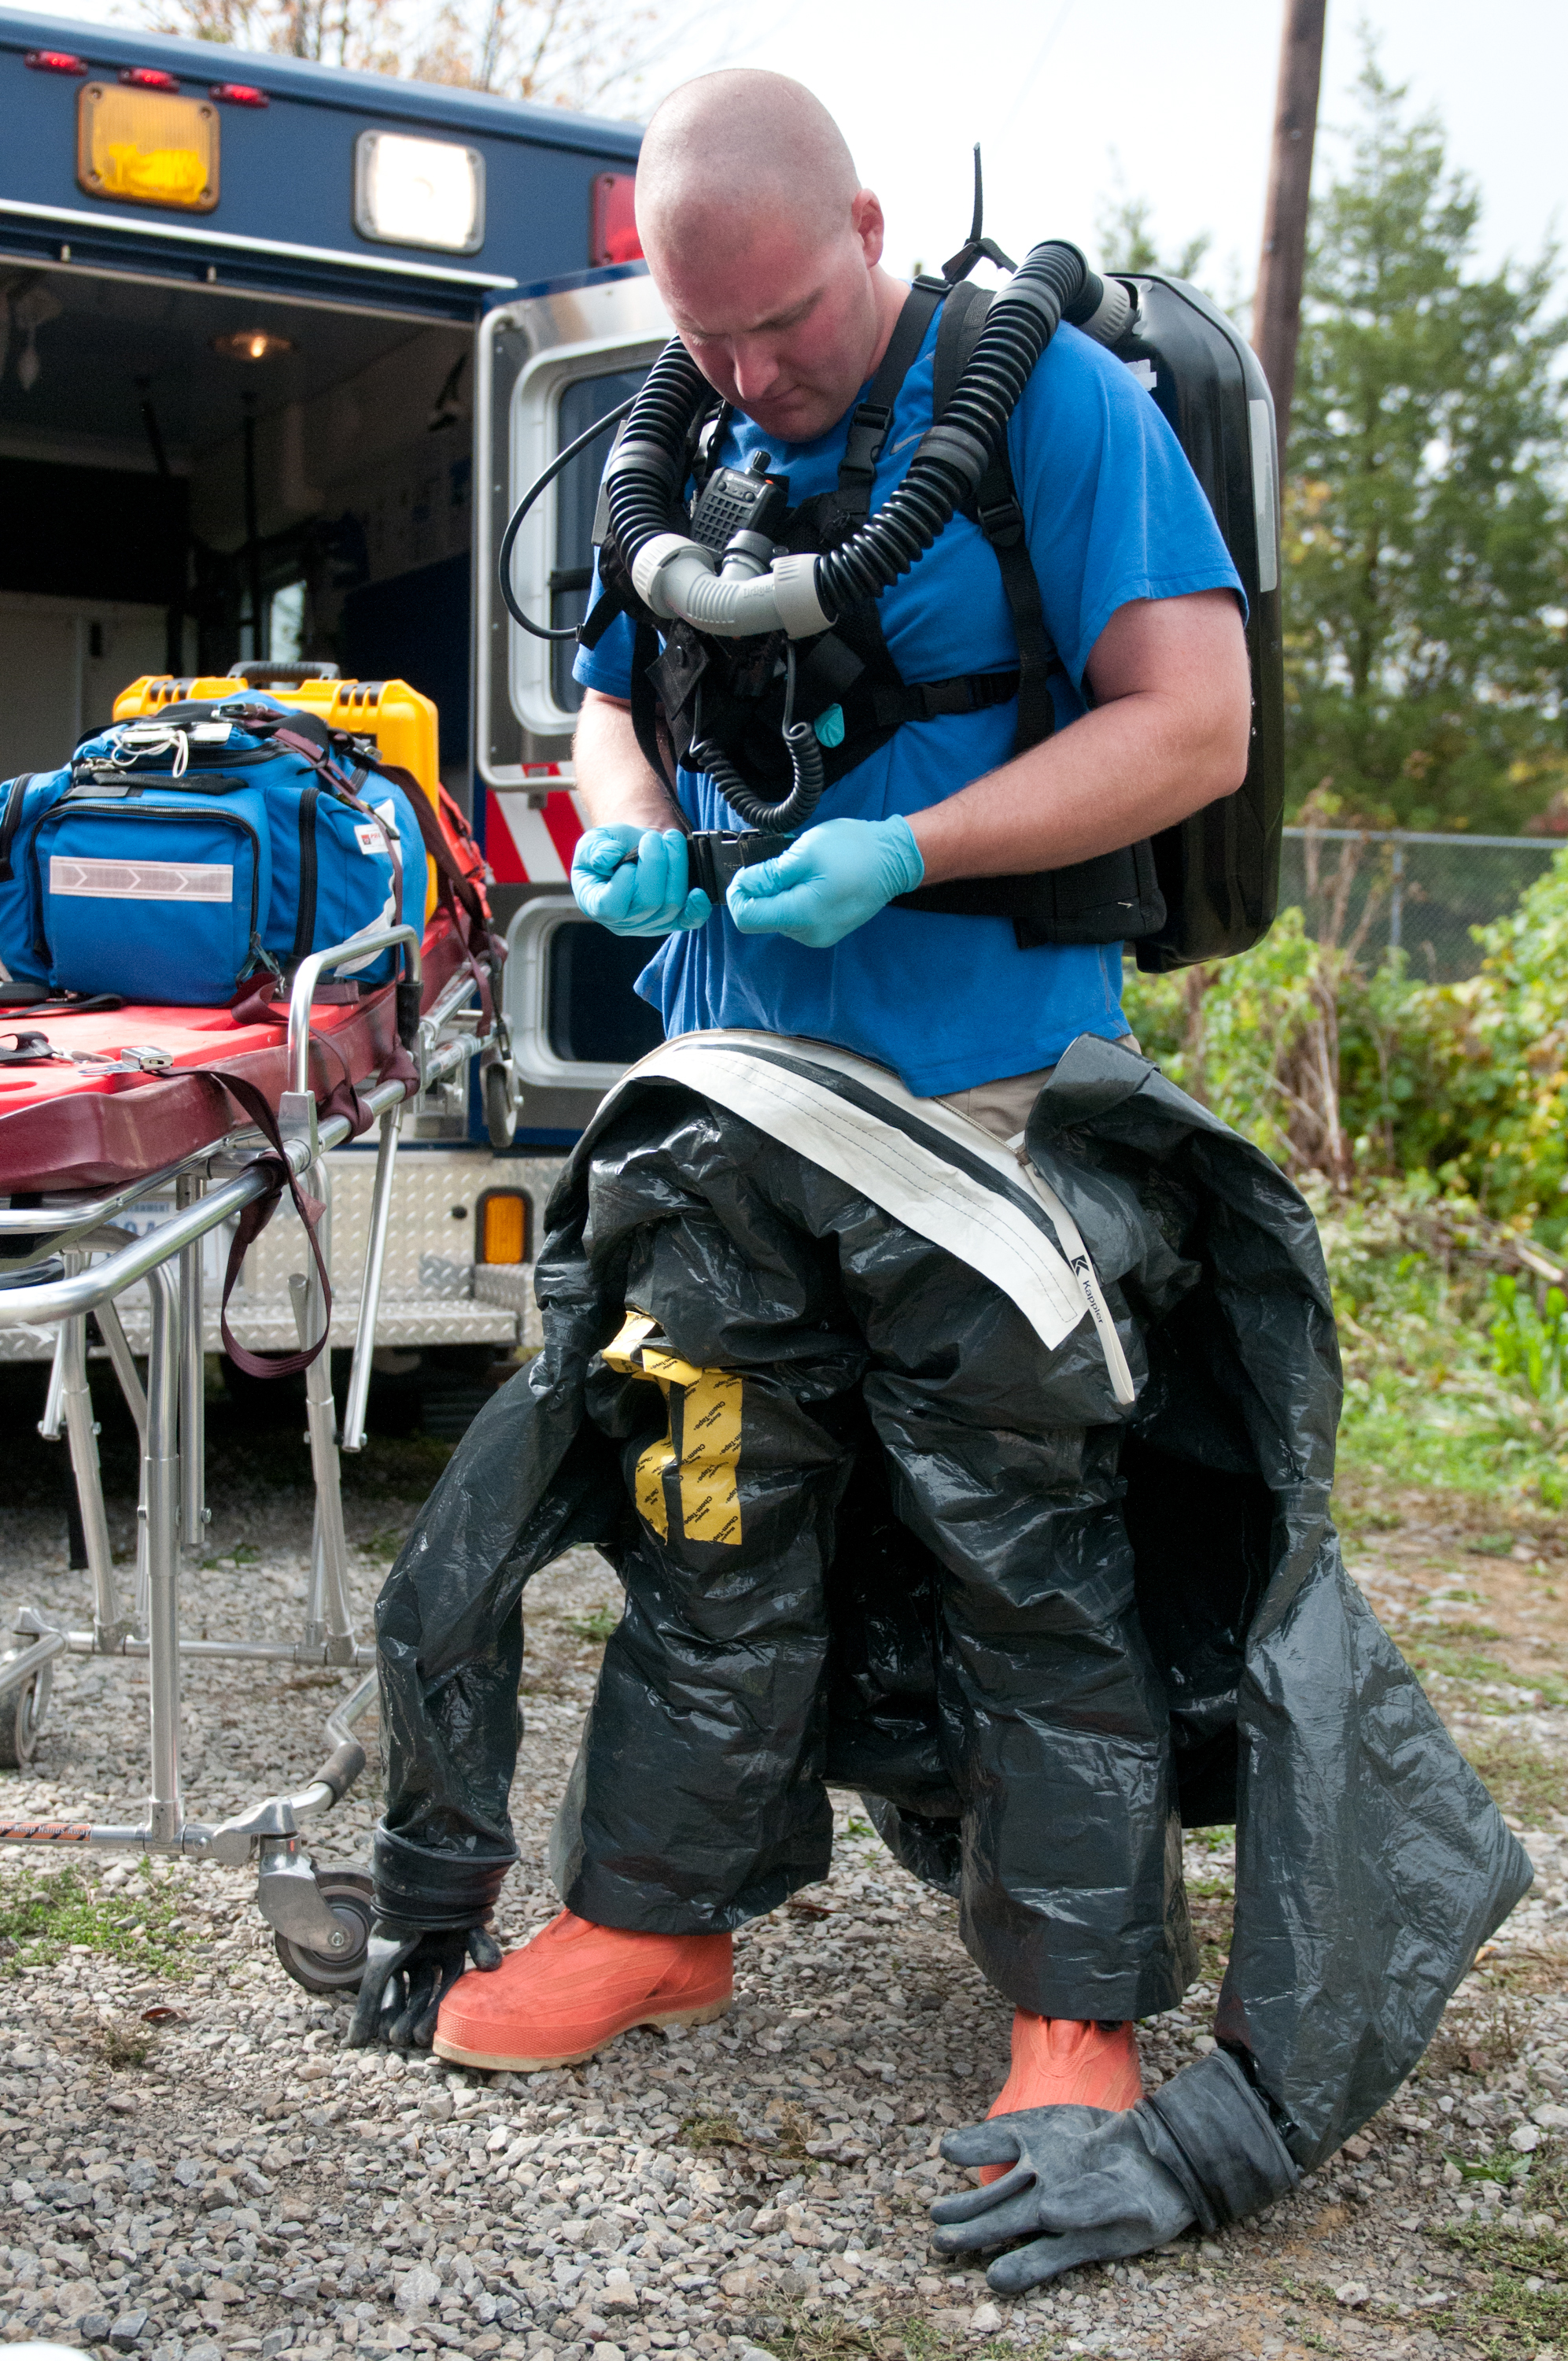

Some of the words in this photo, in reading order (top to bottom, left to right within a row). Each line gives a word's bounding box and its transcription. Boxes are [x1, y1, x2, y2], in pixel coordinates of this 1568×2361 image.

[1083, 1280, 1103, 1323] Kappler
[14, 1824, 35, 1834] Keep
[38, 1826, 65, 1834] Hands
[67, 1827, 90, 1836] Away
